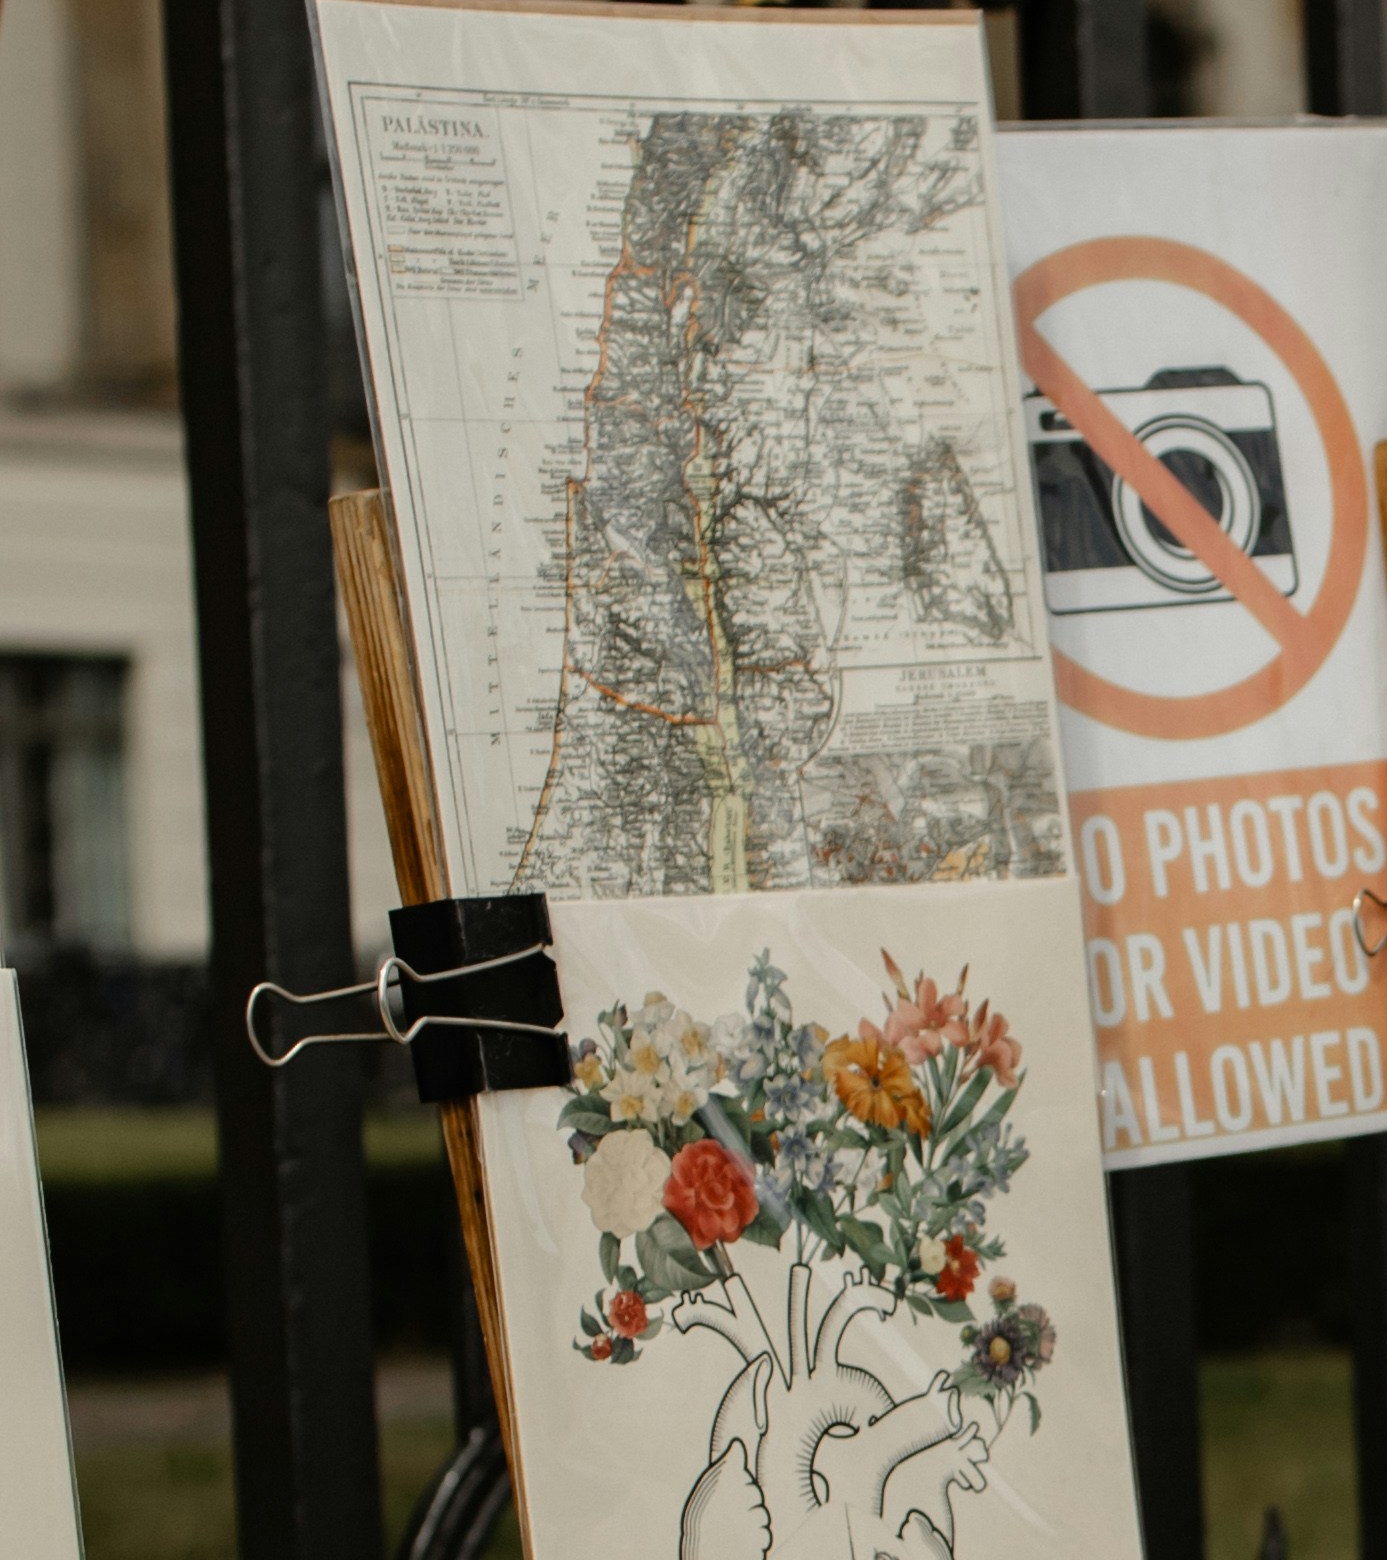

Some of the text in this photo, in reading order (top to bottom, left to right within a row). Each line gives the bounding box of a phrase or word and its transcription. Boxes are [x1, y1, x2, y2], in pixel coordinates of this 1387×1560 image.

[1080, 786, 1387, 906] O PHOTOS
[1087, 906, 1370, 1028] OR VIDEO
[1101, 1026, 1385, 1151] ALLOWED
